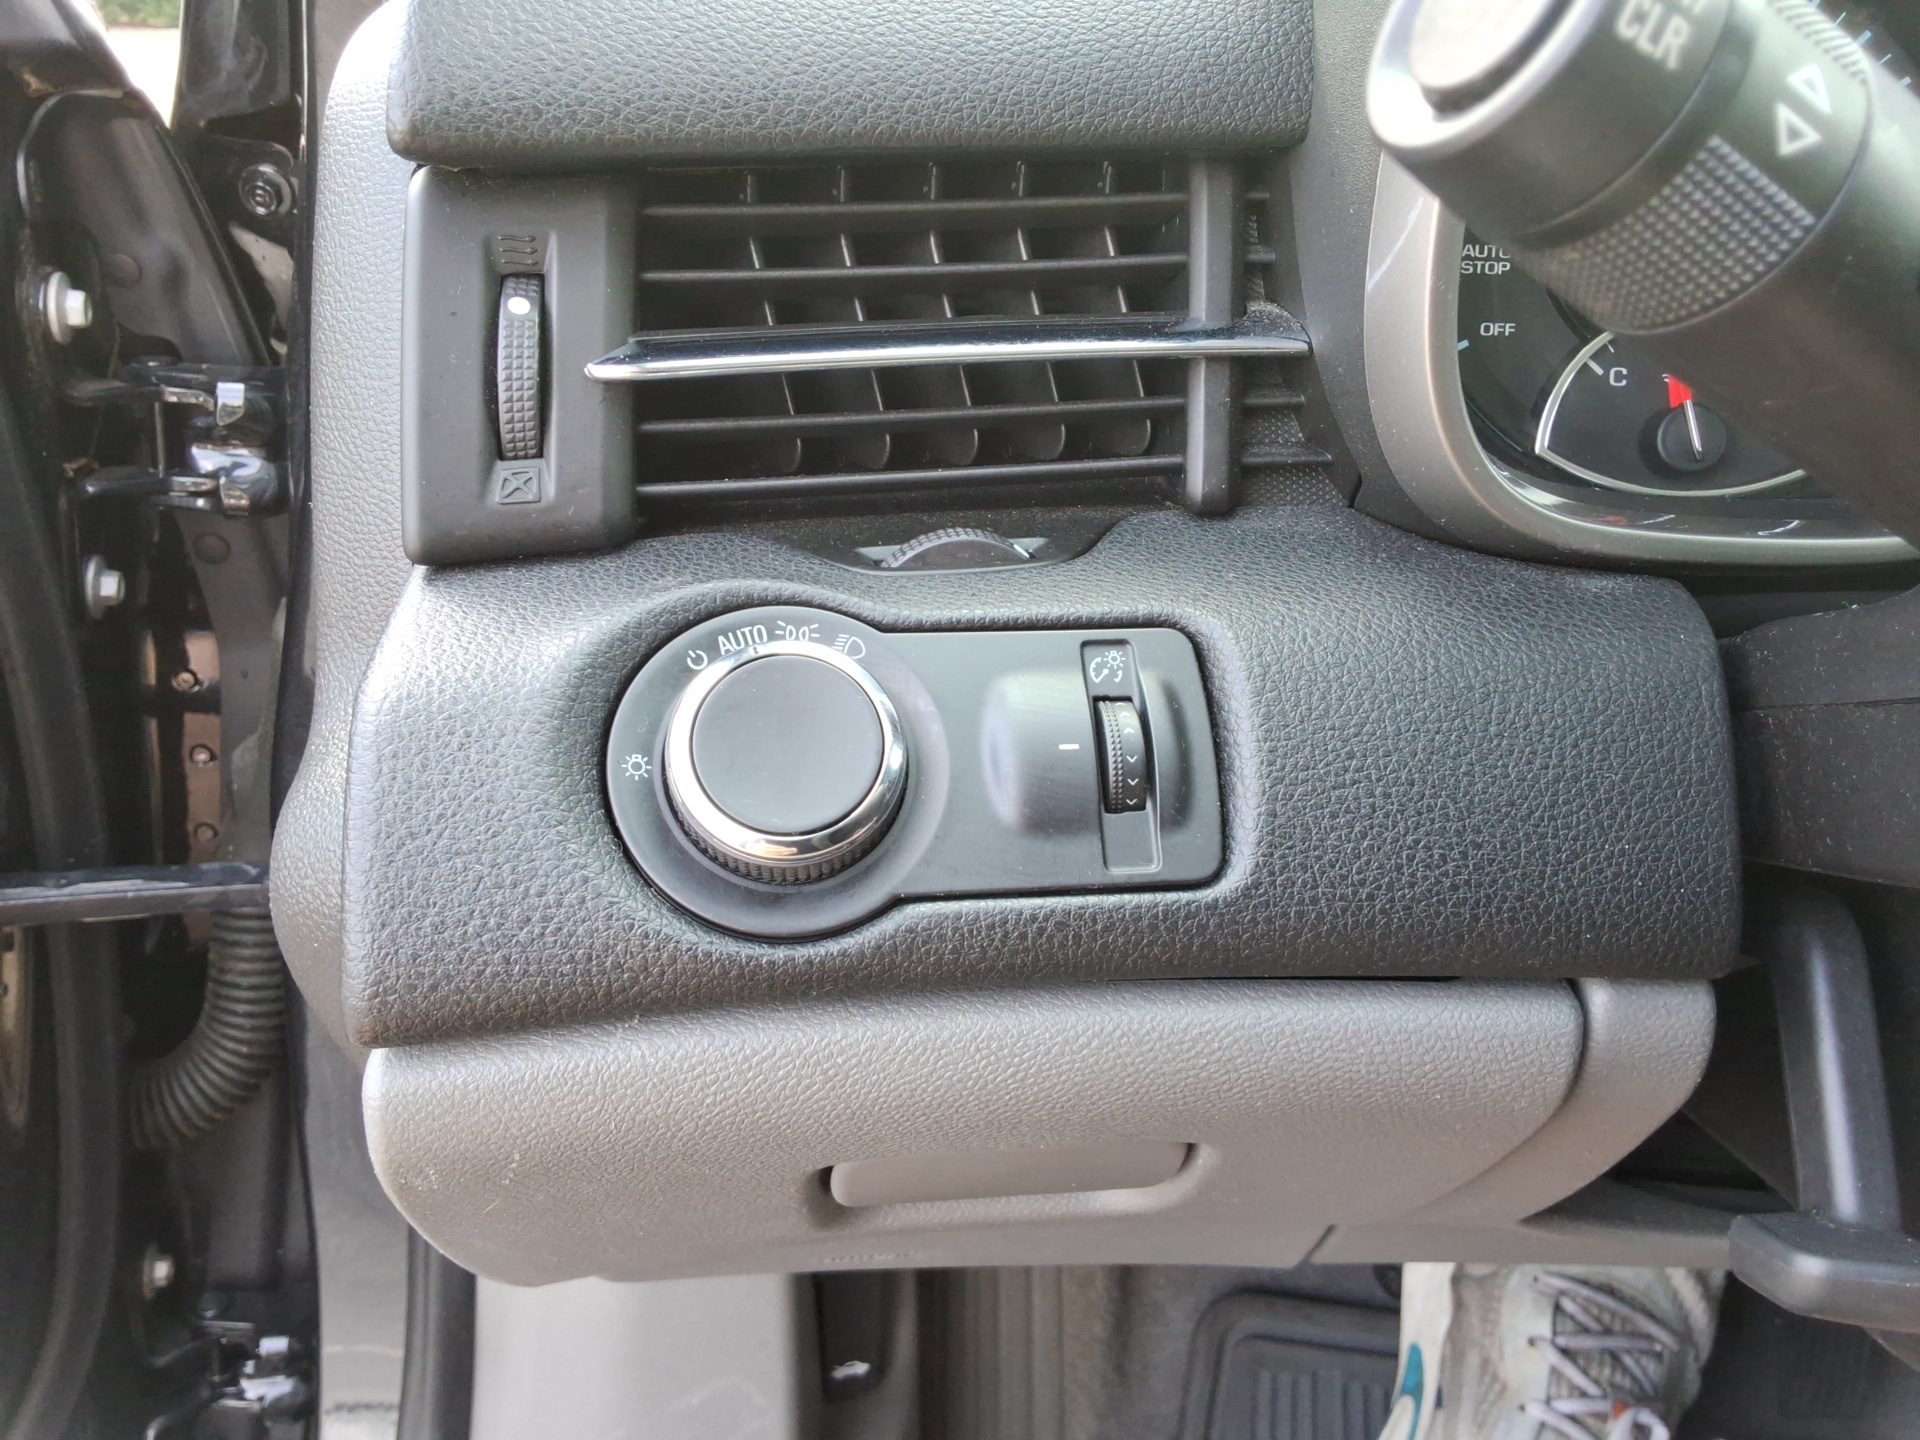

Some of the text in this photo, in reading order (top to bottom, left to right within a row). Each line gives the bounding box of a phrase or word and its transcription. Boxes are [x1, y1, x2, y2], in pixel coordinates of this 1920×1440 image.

[1616, 0, 1691, 71] CLR
[1461, 260, 1511, 275] STOP
[1480, 322, 1516, 336] OFF
[1609, 367, 1628, 386] C
[717, 624, 768, 656] AUTO
